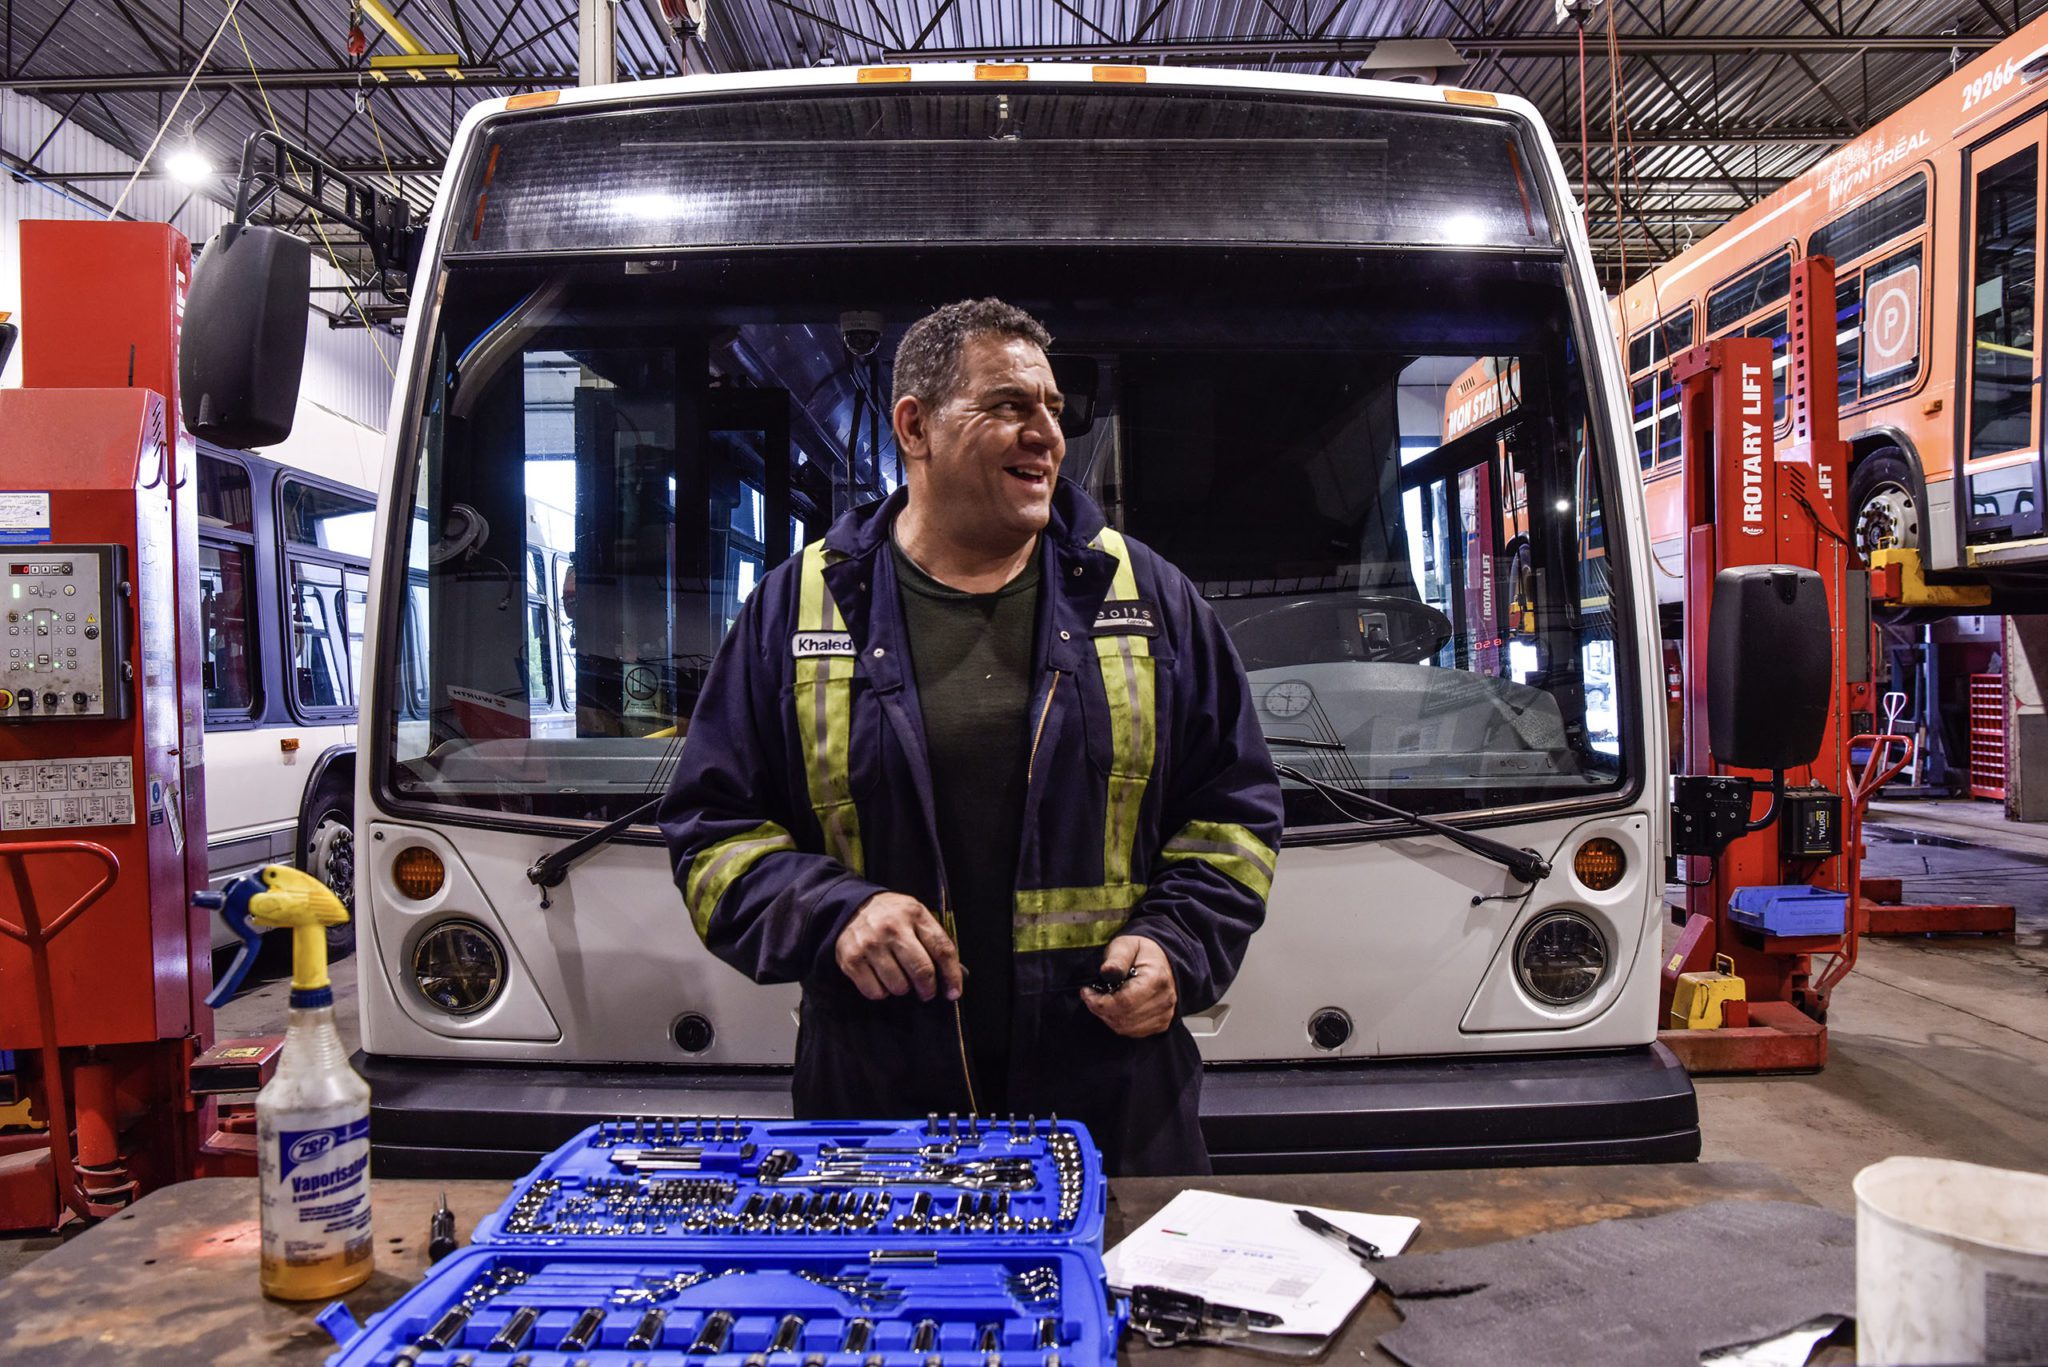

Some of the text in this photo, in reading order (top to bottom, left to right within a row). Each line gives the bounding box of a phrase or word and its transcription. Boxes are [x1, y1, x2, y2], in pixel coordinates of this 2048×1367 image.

[1961, 56, 2014, 112] 29266
[1448, 368, 1520, 438] MON STATON
[1742, 363, 1762, 522] ROTARY LIFT
[1482, 553, 1492, 616] ROTARY LIFT
[798, 638, 853, 652] Khaled
[1818, 810, 1826, 840] DIGITAL
